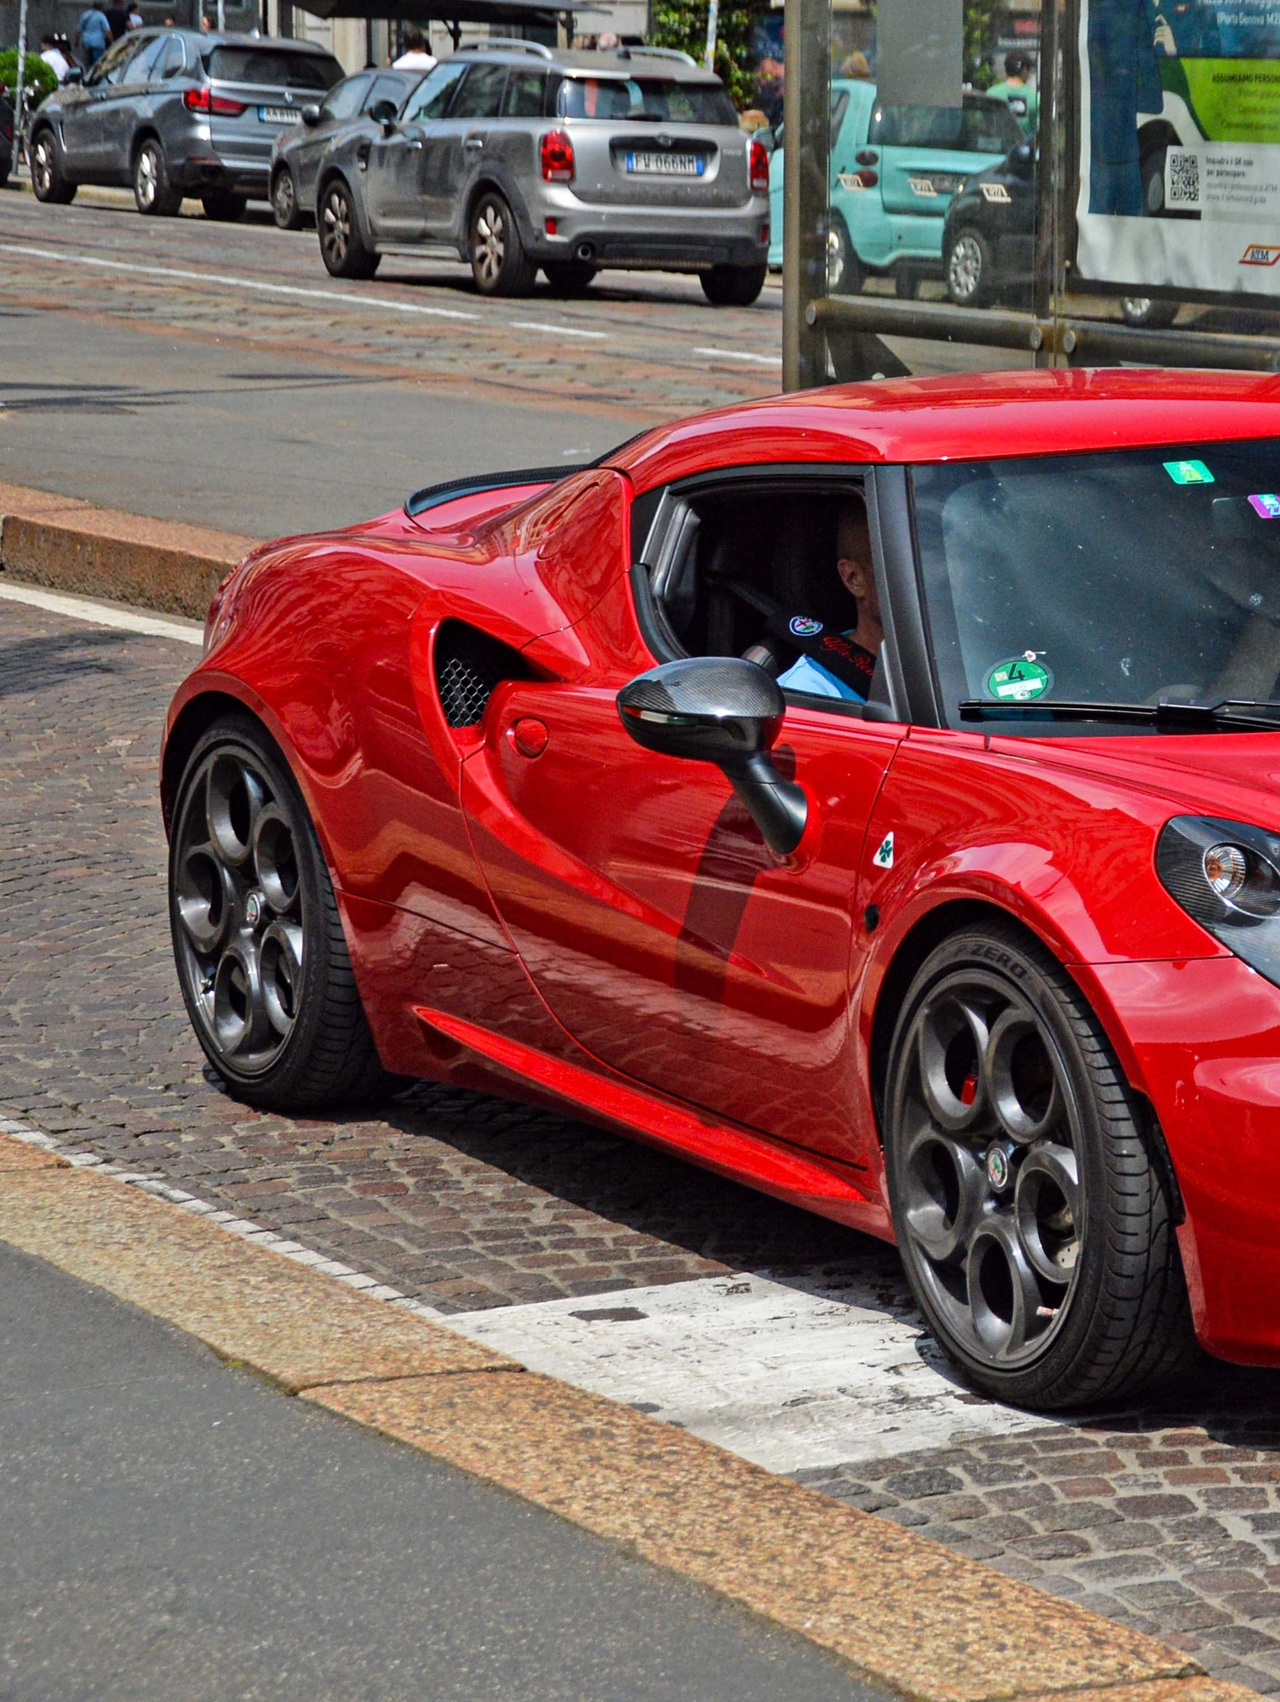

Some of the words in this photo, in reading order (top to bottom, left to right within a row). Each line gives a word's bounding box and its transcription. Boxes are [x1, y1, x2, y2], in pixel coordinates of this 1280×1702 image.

[1250, 249, 1270, 261] ATM
[1008, 663, 1026, 681] 4
[971, 944, 1028, 979] ZERO
